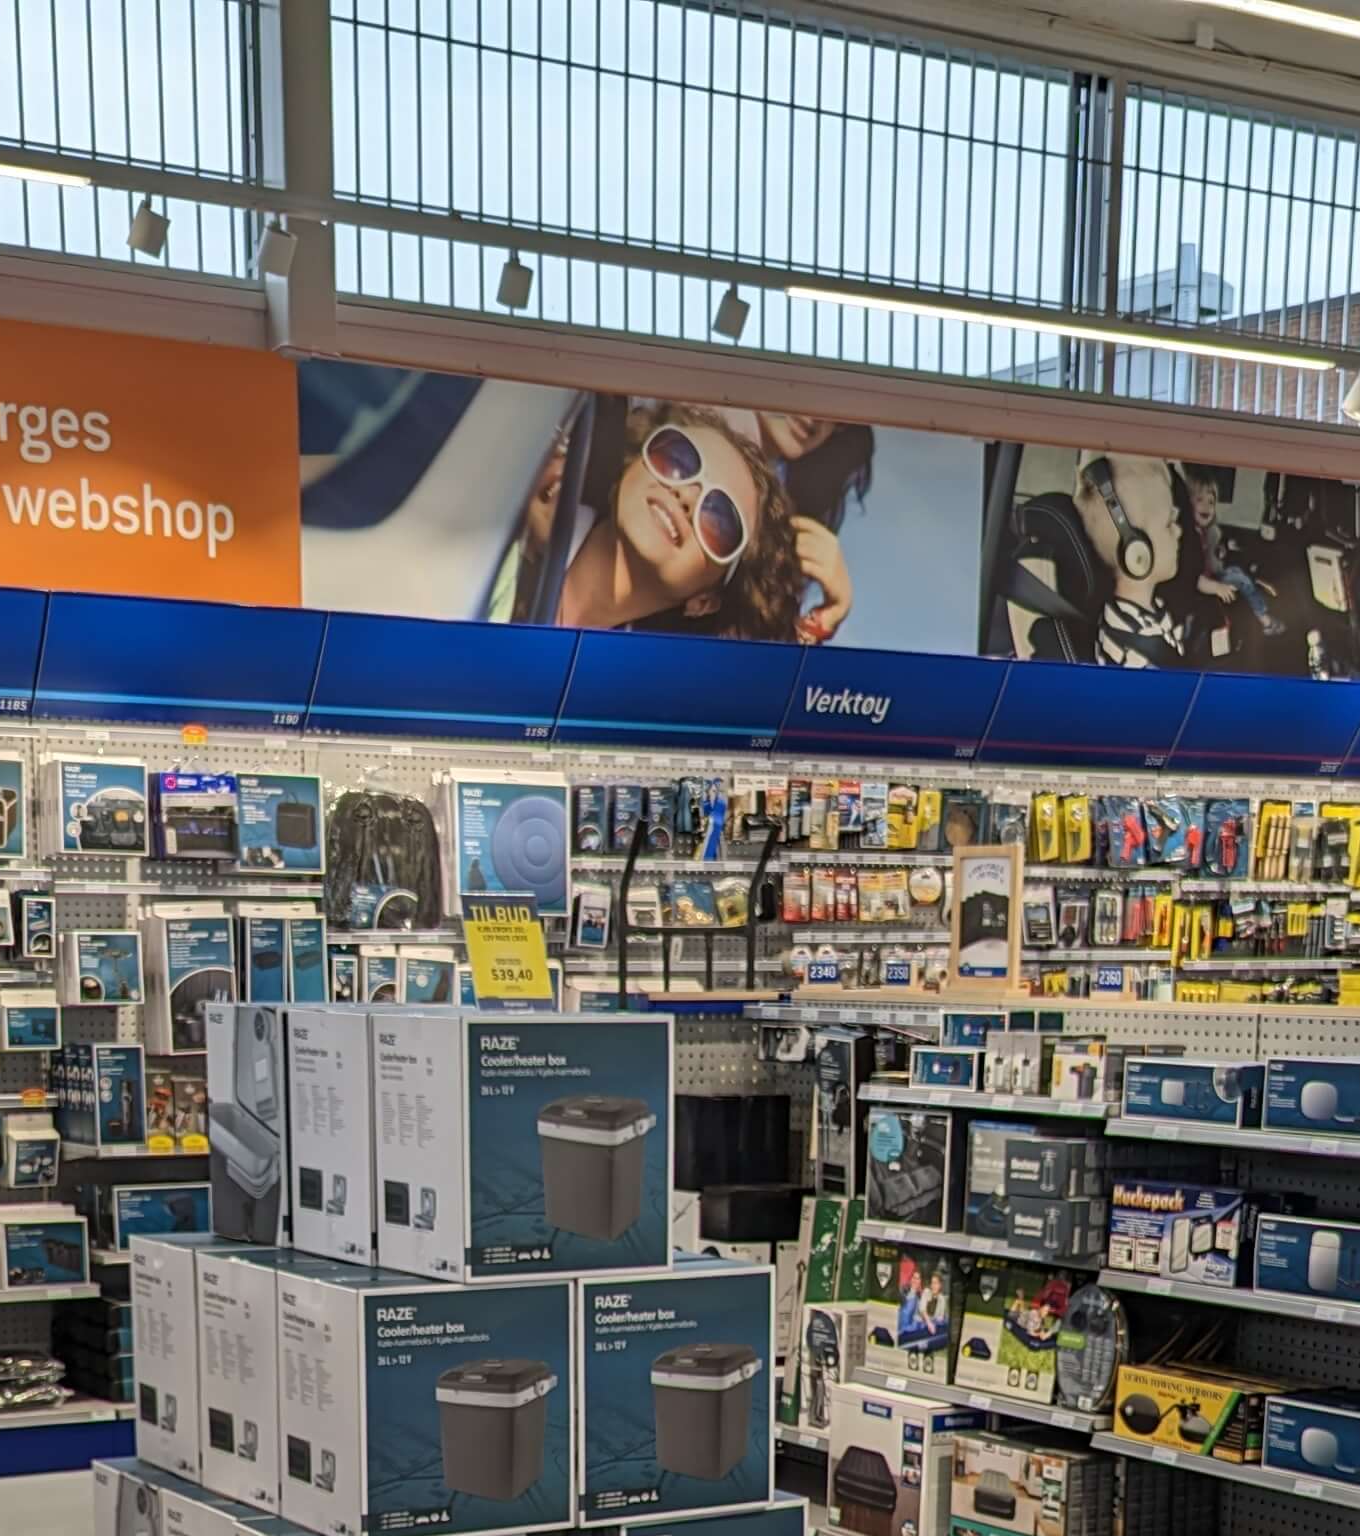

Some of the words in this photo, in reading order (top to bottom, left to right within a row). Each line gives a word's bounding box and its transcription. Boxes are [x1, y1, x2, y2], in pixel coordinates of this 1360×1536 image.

[3, 477, 235, 558] webshop
[805, 686, 891, 725] Verktøy
[469, 905, 531, 923] TILBUD
[810, 965, 836, 980] 2340
[1098, 971, 1122, 987] 2360
[480, 1036, 520, 1050] RAZE
[547, 1053, 567, 1066] box
[595, 1294, 631, 1309] RAZE
[376, 1307, 417, 1322] RAZE
[657, 1308, 675, 1320] box
[446, 1322, 465, 1334] box
